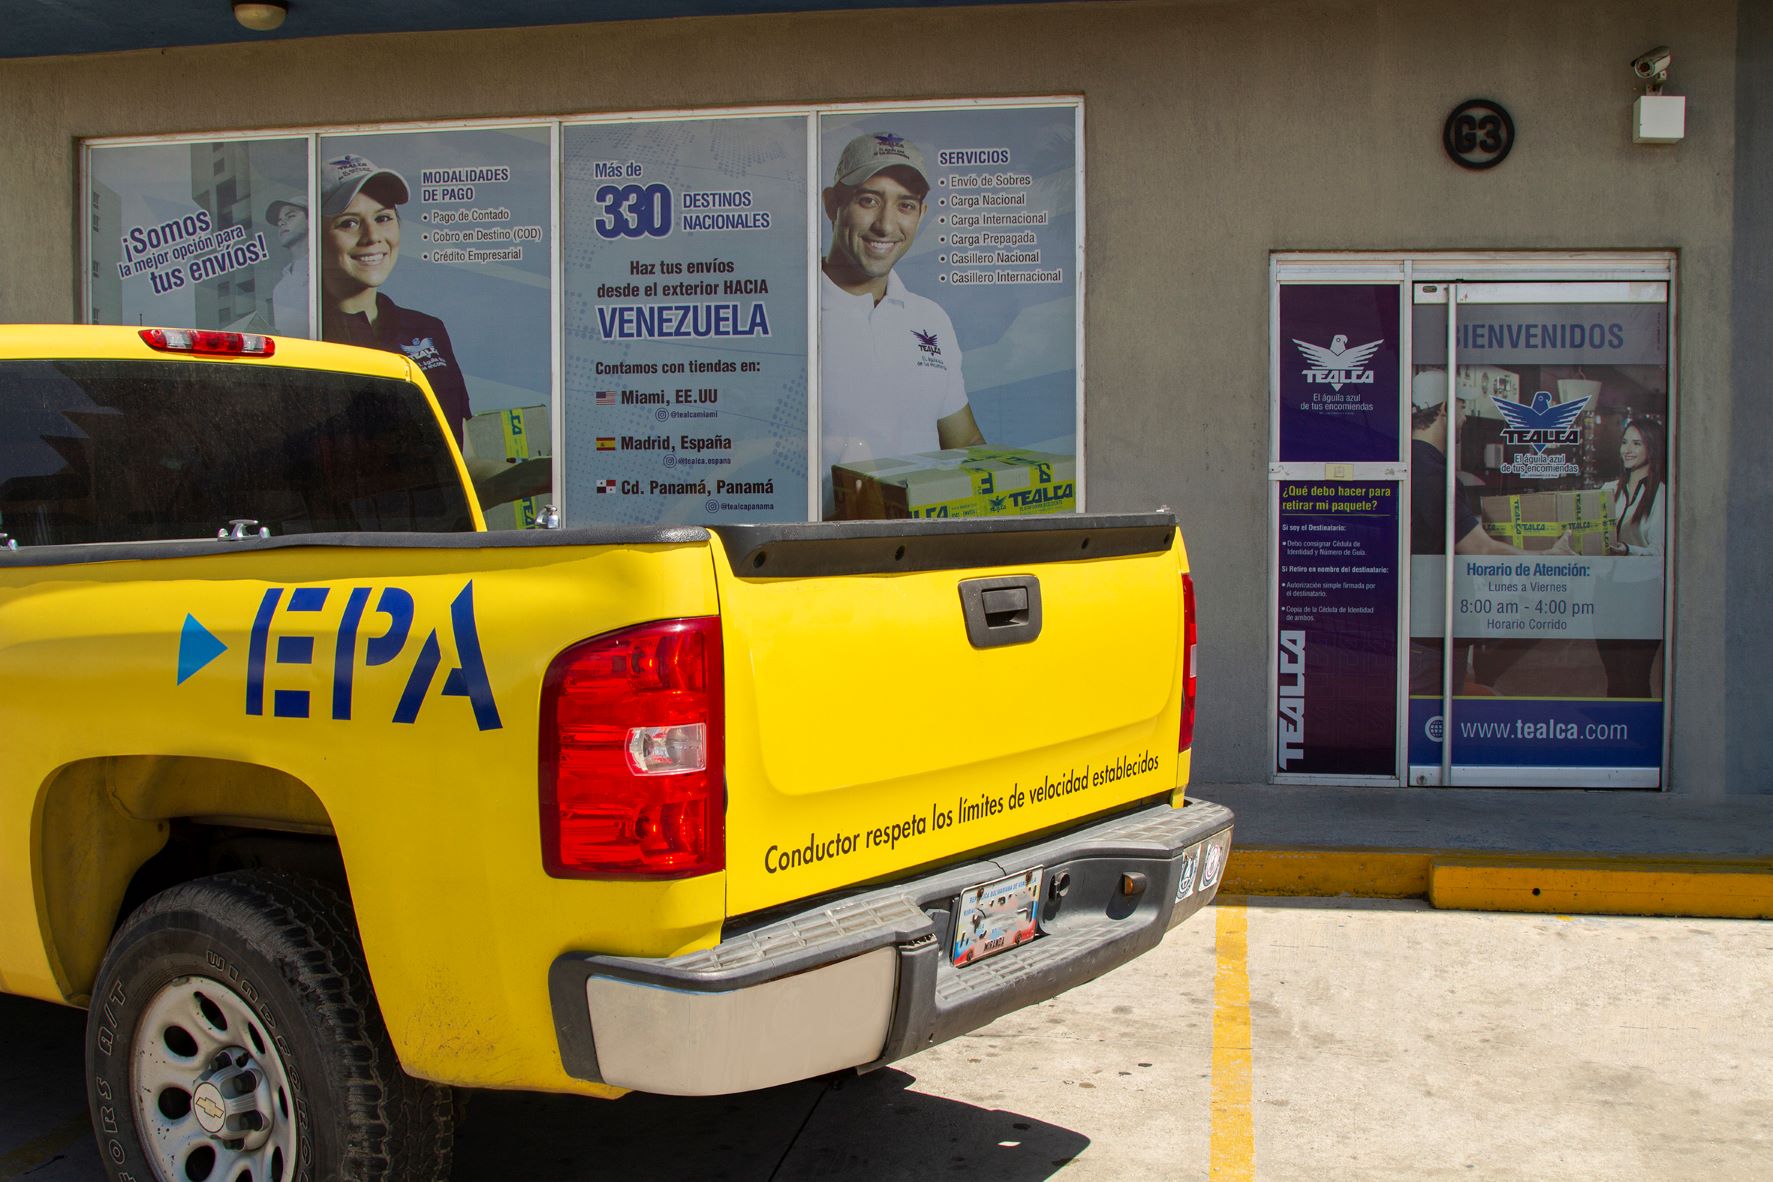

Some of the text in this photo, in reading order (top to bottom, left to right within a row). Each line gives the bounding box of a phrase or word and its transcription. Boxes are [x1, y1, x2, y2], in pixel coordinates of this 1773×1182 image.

[1455, 115, 1502, 154] G3
[940, 150, 1009, 165] SERVICIOS
[422, 168, 509, 184] MODALIDADES
[595, 162, 642, 178] Más de
[951, 175, 1031, 187] Envío de Sobres
[423, 187, 474, 201] DE PAGO
[683, 191, 752, 209] DESTINOS
[951, 194, 1025, 208] Carga Nacional
[433, 209, 510, 223] Pago de Contado
[595, 183, 672, 239] 330
[683, 213, 770, 231] NACIONALES
[951, 213, 1047, 227] Carga Internacional
[122, 210, 212, 263] ¡Somos
[433, 227, 542, 242] Cobro en Destino (COD)
[951, 232, 1035, 246] Carga Prepagada
[118, 226, 244, 278] la mejor opción para
[433, 249, 521, 262] Crédito Empresarial
[951, 251, 1039, 264] Casillero Nacional
[150, 234, 268, 294] tus envíos!
[630, 258, 735, 276] Haz tus envíos
[951, 270, 1061, 284] Casillero Internacional
[597, 279, 769, 298] desde el exterior HACIA
[597, 303, 770, 339] VENEZUELA
[595, 360, 761, 375] Contamos con tiendas en:
[1301, 370, 1374, 384] TEALCA
[621, 388, 718, 406] Miami, EE.UU
[1313, 393, 1361, 403] El águila azul
[1301, 402, 1374, 411] de tus encomiendas
[621, 434, 732, 454] Madrid, España
[1501, 429, 1579, 445] TEALCA
[1514, 454, 1566, 464] El águila azul
[1501, 463, 1578, 473] de tus encomiendas
[621, 478, 774, 497] Cd. Panamá, Panamá
[1282, 485, 1391, 498] ¿Qué debo hacer para
[1008, 484, 1073, 508] TEALCA
[1282, 500, 1378, 512] retirar mi paquete?
[1466, 562, 1591, 578] Horario de Atención:
[1488, 582, 1567, 593] Lunes a Viernes
[1460, 599, 1492, 614] 8:00
[1496, 603, 1519, 614] am
[1534, 600, 1567, 615] 4:00
[1571, 603, 1595, 618] pm
[1487, 618, 1568, 630] Horario Corrido
[245, 579, 504, 732] EPA
[1279, 630, 1306, 772] TEALCA
[1460, 718, 1628, 740] www.tealca.com
[764, 749, 1159, 874] Conductor respeta los límites de velocidad establecidos
